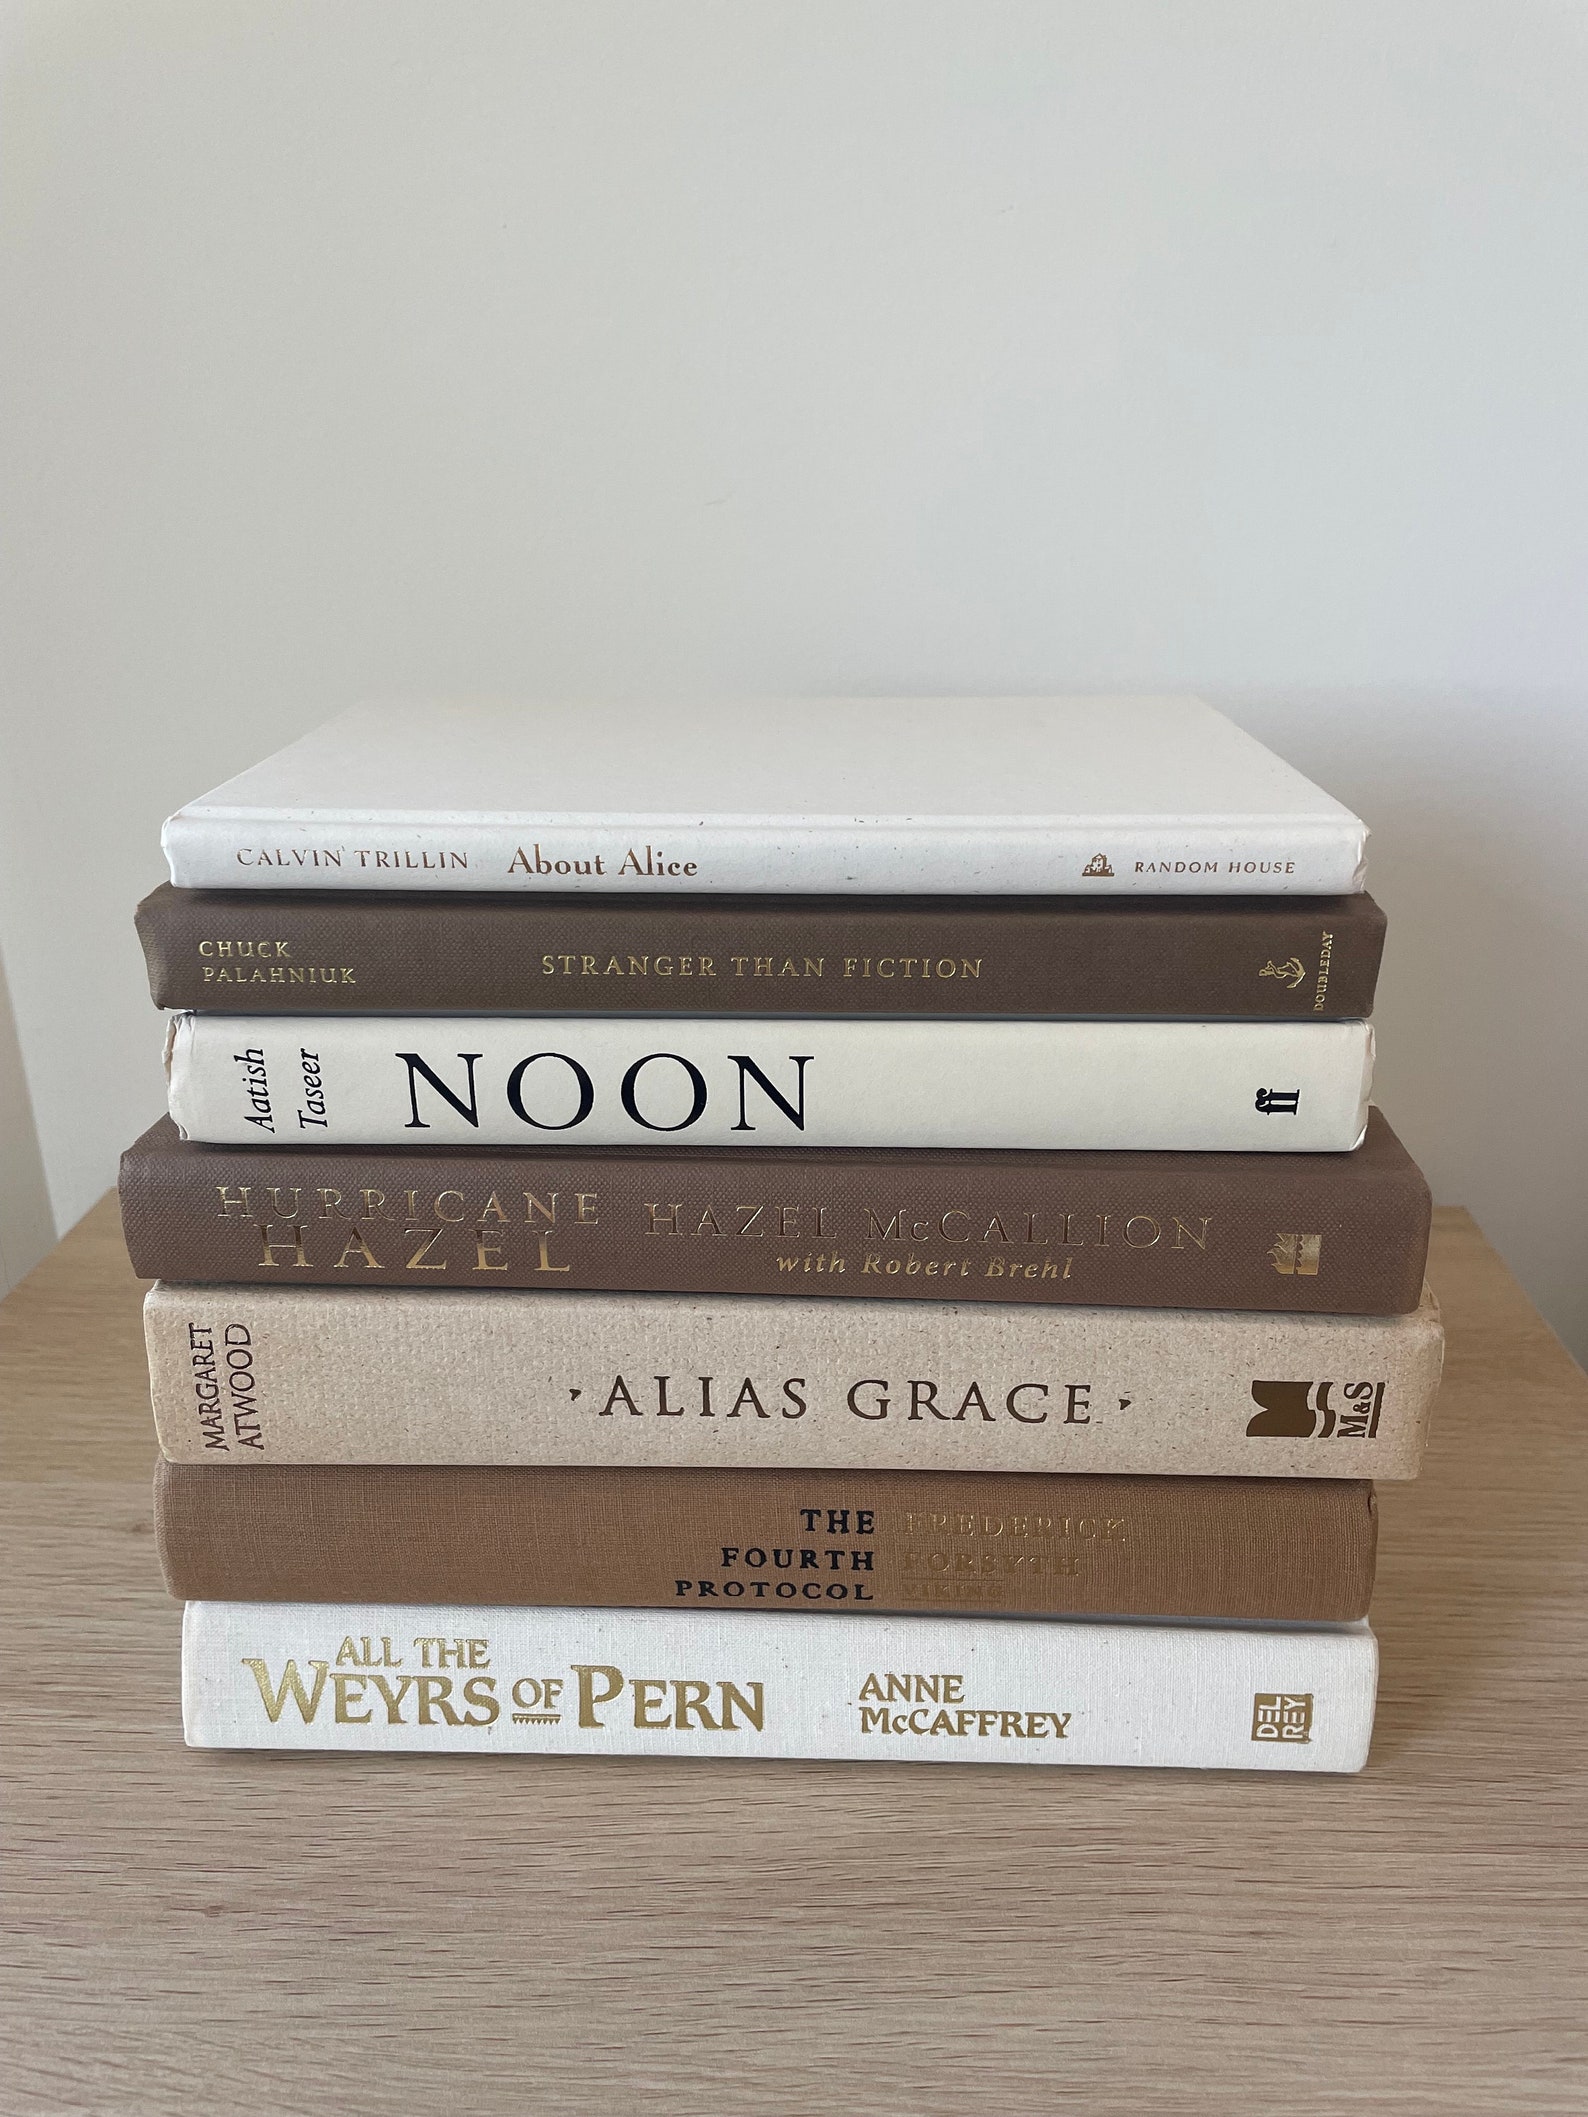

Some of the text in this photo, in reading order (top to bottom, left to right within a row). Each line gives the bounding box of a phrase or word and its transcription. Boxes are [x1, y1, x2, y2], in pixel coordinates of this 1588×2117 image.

[236, 848, 468, 869] CALVIN TRILLIN
[508, 843, 698, 877] About Alice
[1135, 862, 1295, 873] RANDOM HOUSE
[199, 941, 290, 959] CHUCK
[541, 955, 982, 979] STRANGER THAN FICTION
[203, 966, 356, 984] PALAHNIUK
[1313, 931, 1334, 1011] DOUBLEDAY
[234, 1048, 275, 1133] Aatish
[297, 1048, 328, 1129] Taseer
[395, 1052, 814, 1132] NOON
[216, 1186, 599, 1224] HURRICANE
[644, 1203, 1212, 1251] HAZEL McCALLION
[254, 1224, 570, 1272] HAZEL
[776, 1252, 1073, 1279] with Robert Brehl
[190, 1323, 229, 1450] MARGARET
[225, 1324, 264, 1450] ATWOOD
[599, 1375, 1092, 1424] ALIAS GRACE
[1337, 1381, 1373, 1438] M&S
[800, 1509, 875, 1535] THE
[905, 1511, 1127, 1542] FREDERICK
[721, 1548, 875, 1573] FOURTH
[903, 1551, 1080, 1577] FORSYTH
[675, 1581, 874, 1601] PROTOCOL
[336, 1636, 491, 1669] ALL THE
[241, 1657, 764, 1732] WEYRS OF PERN
[859, 1674, 965, 1704] ANNE
[860, 1706, 1071, 1739] McCAFFREY
[1256, 1696, 1282, 1738] DEL
[1282, 1696, 1306, 1738] REY
